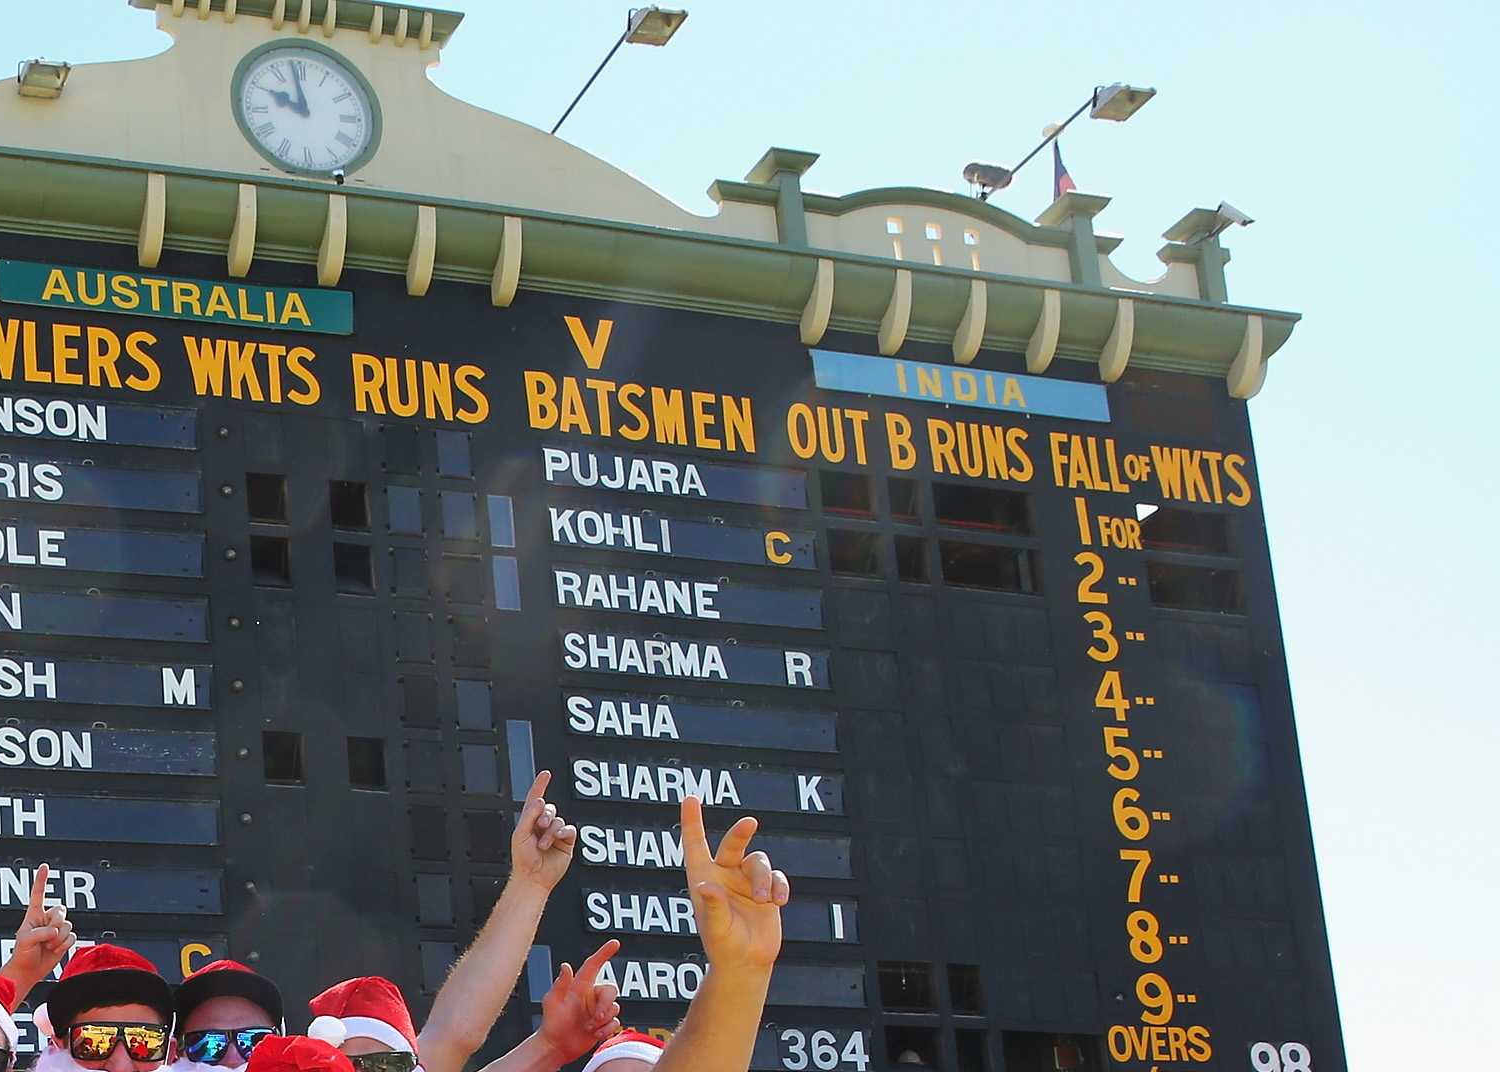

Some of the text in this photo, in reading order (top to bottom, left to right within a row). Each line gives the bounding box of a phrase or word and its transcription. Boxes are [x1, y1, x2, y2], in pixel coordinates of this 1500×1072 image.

[42, 269, 311, 326] AUSTRALIA
[564, 316, 613, 370] V
[183, 336, 320, 405] WKTS
[352, 353, 490, 423] RUNS
[897, 363, 1027, 408] INDIA
[523, 371, 1252, 507] BATSMEN OUT B RUNS FALL OF WKTS
[543, 448, 707, 496] PUJARA
[549, 507, 793, 565] KOHLI C
[1098, 516, 1141, 550] FOR
[555, 571, 720, 620] RAHANE
[1074, 552, 1108, 604] 2
[564, 632, 813, 686] SHARMA R
[1083, 611, 1118, 661] 3
[163, 668, 196, 705] M
[1095, 671, 1130, 721] 4
[567, 697, 679, 739] SAHA
[1103, 727, 1139, 780] 5
[573, 760, 825, 811] SHARMA K
[1112, 788, 1150, 840] 6
[580, 826, 684, 868] SHAM
[1119, 849, 1151, 902] 7
[587, 893, 696, 936] SHAR
[1126, 910, 1163, 963] 8
[181, 943, 211, 979] C
[594, 962, 708, 999] AARO
[1135, 973, 1173, 1025] 9
[781, 1029, 869, 1072] 364
[1108, 1025, 1211, 1063] OVERS
